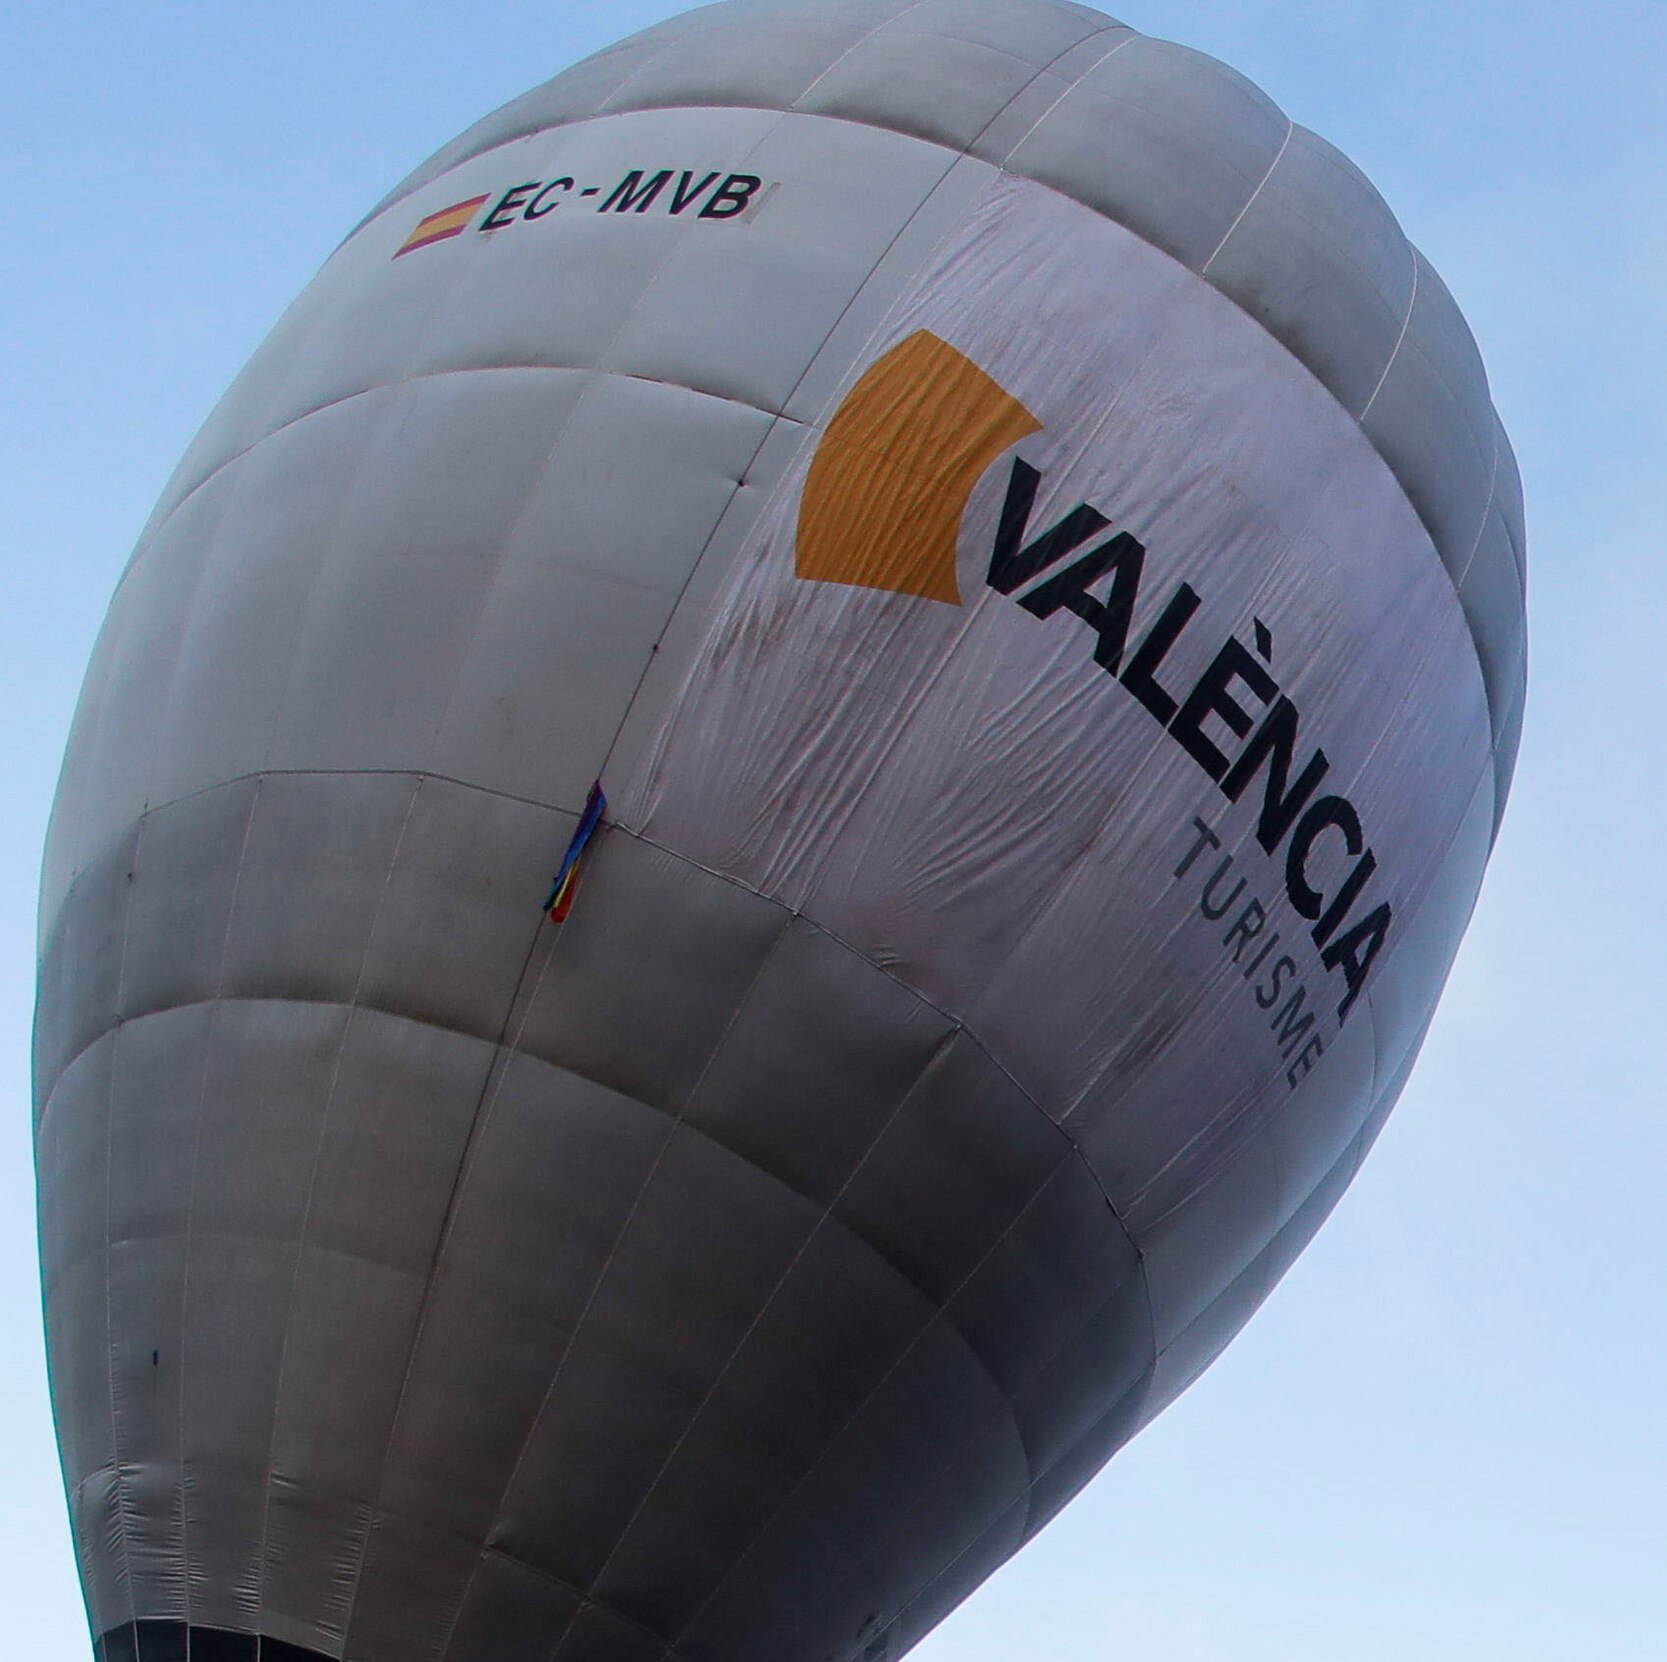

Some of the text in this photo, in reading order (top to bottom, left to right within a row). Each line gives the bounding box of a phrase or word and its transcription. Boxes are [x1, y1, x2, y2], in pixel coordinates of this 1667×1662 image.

[478, 170, 762, 232] EC-MVB
[986, 456, 1394, 1027] VALÈNCIA
[1173, 816, 1323, 1089] TURISME
